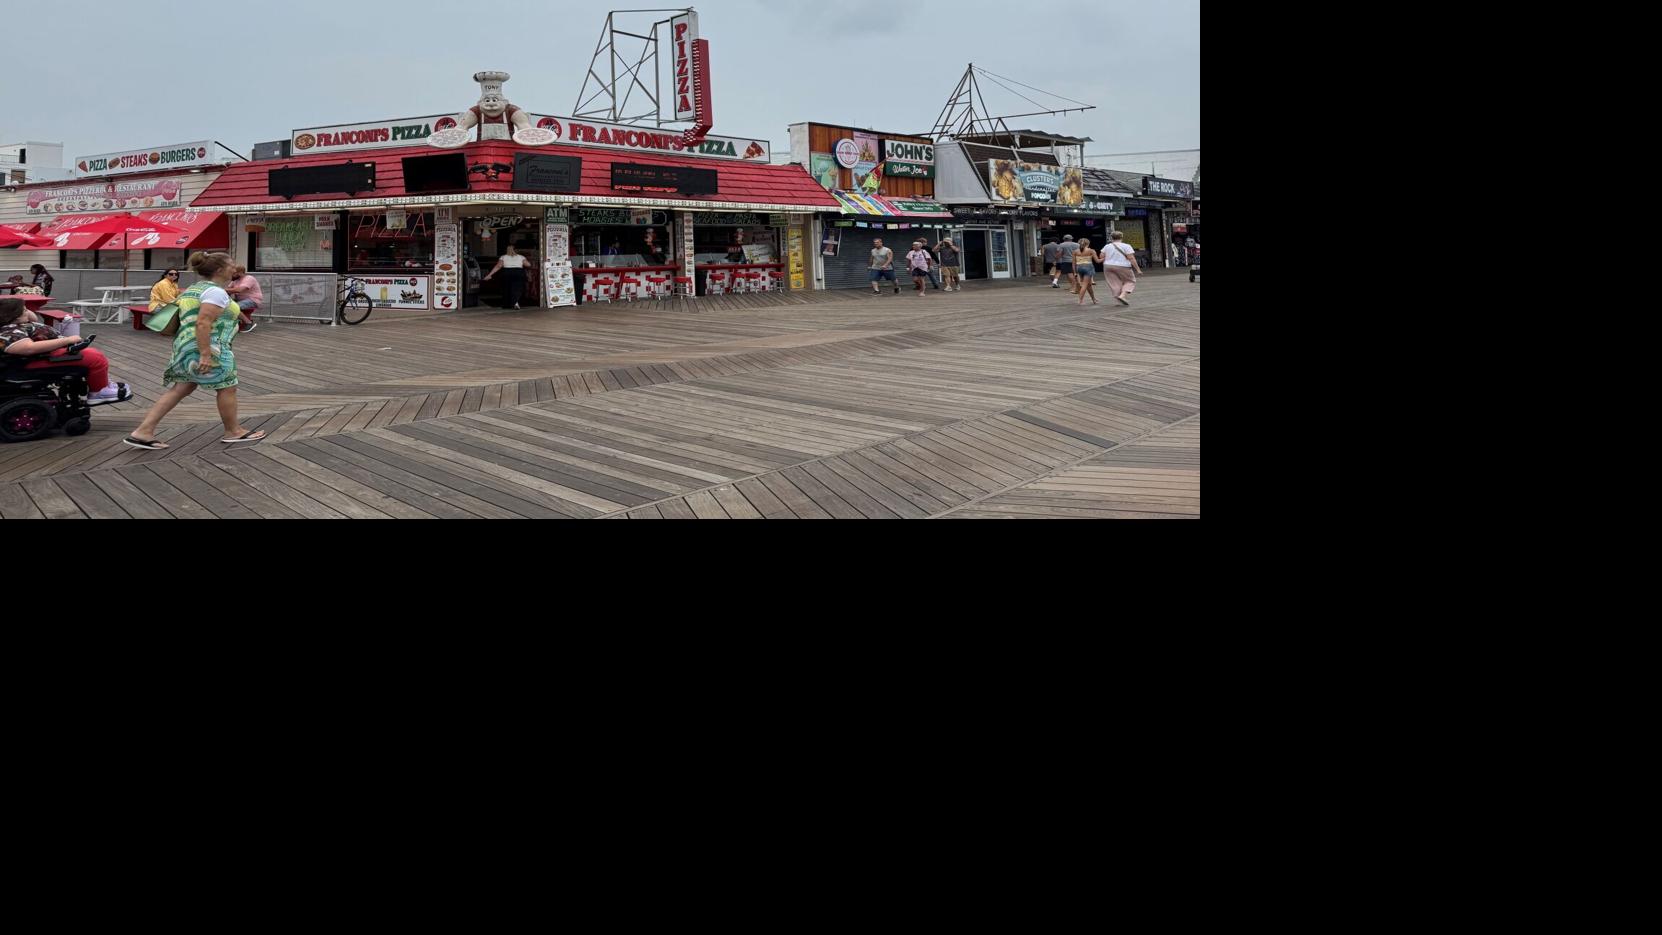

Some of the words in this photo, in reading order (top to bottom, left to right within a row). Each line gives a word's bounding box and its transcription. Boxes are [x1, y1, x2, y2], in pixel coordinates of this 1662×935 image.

[675, 23, 691, 112] PIZZA
[316, 128, 390, 147] FRANCONI'S
[392, 123, 432, 141] PIZZA
[568, 123, 684, 151] FRANCONI'S
[88, 159, 108, 172] PIZZA
[120, 153, 148, 168] STEAKS
[160, 147, 197, 164] BURGERS
[887, 142, 934, 162] JOHN'S
[107, 184, 113, 193] &
[1148, 180, 1161, 192] THE
[1160, 182, 1176, 194] ROCK
[482, 216, 518, 227] OPEN
[546, 207, 568, 218] ATM
